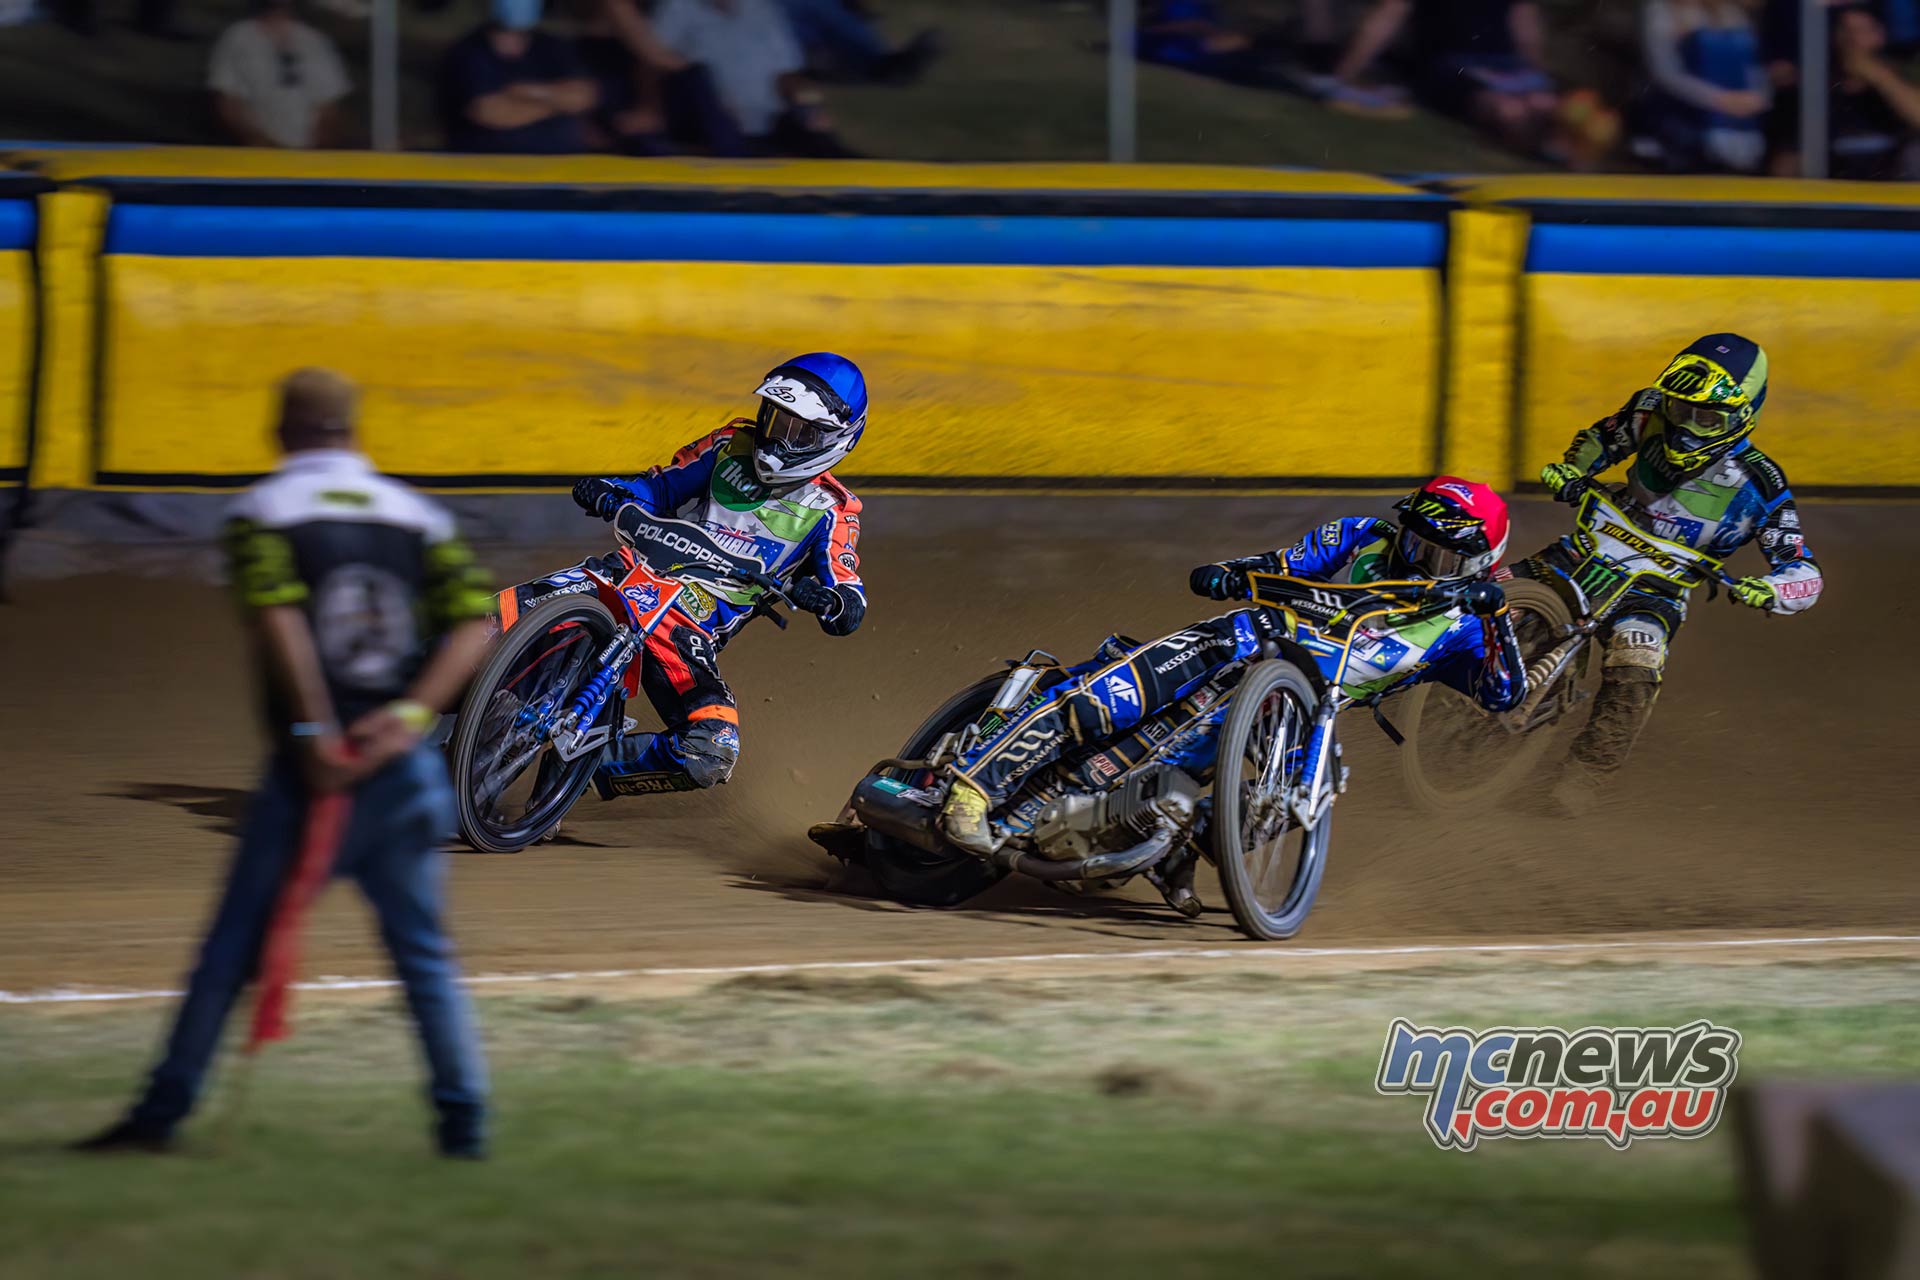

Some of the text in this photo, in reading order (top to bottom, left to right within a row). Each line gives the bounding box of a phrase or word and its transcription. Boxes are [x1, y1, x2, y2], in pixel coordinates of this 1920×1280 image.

[720, 460, 766, 501] ikon
[1603, 523, 1630, 541] TRU
[634, 522, 734, 577] POLCOPPER
[1092, 753, 1118, 776] SPORT
